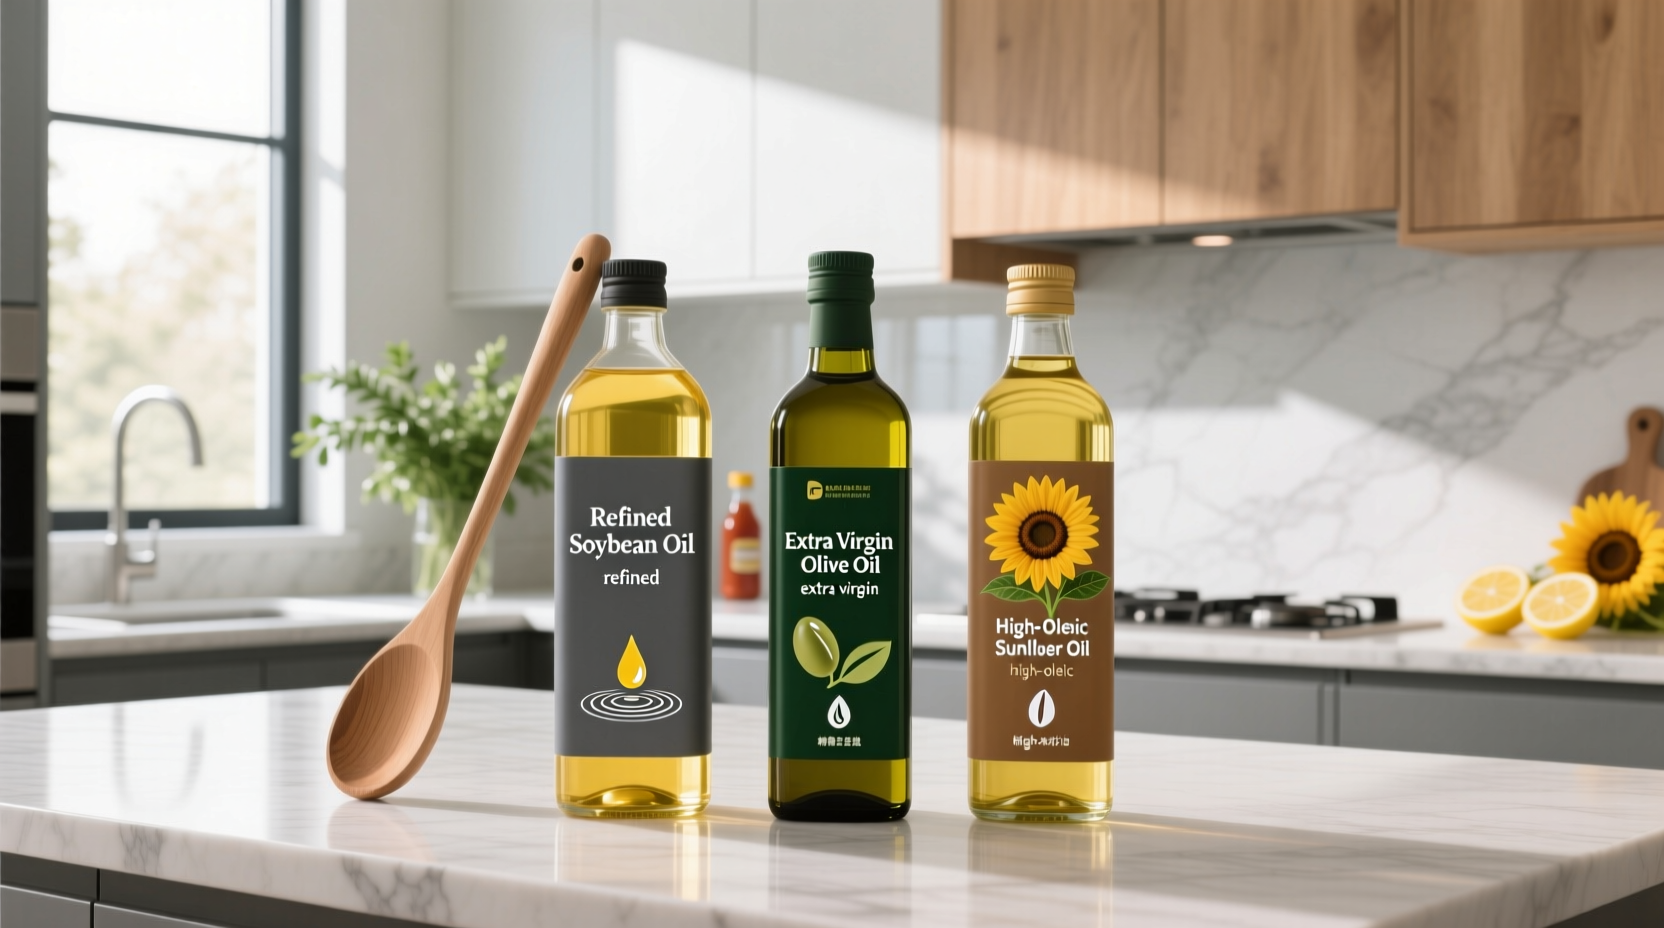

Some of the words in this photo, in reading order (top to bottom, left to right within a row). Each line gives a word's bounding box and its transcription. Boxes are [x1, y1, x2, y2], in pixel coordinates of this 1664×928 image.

[590, 506, 671, 527] Refined
[569, 533, 658, 561] Soybean
[663, 532, 695, 554] Oil
[785, 531, 834, 550] Extra
[836, 531, 894, 555] Virgin
[801, 555, 849, 574] Olive
[853, 555, 880, 574] Oil
[603, 568, 660, 585] refined
[800, 582, 835, 595] extra
[839, 581, 879, 599] virgin
[1066, 640, 1090, 657] Oil
